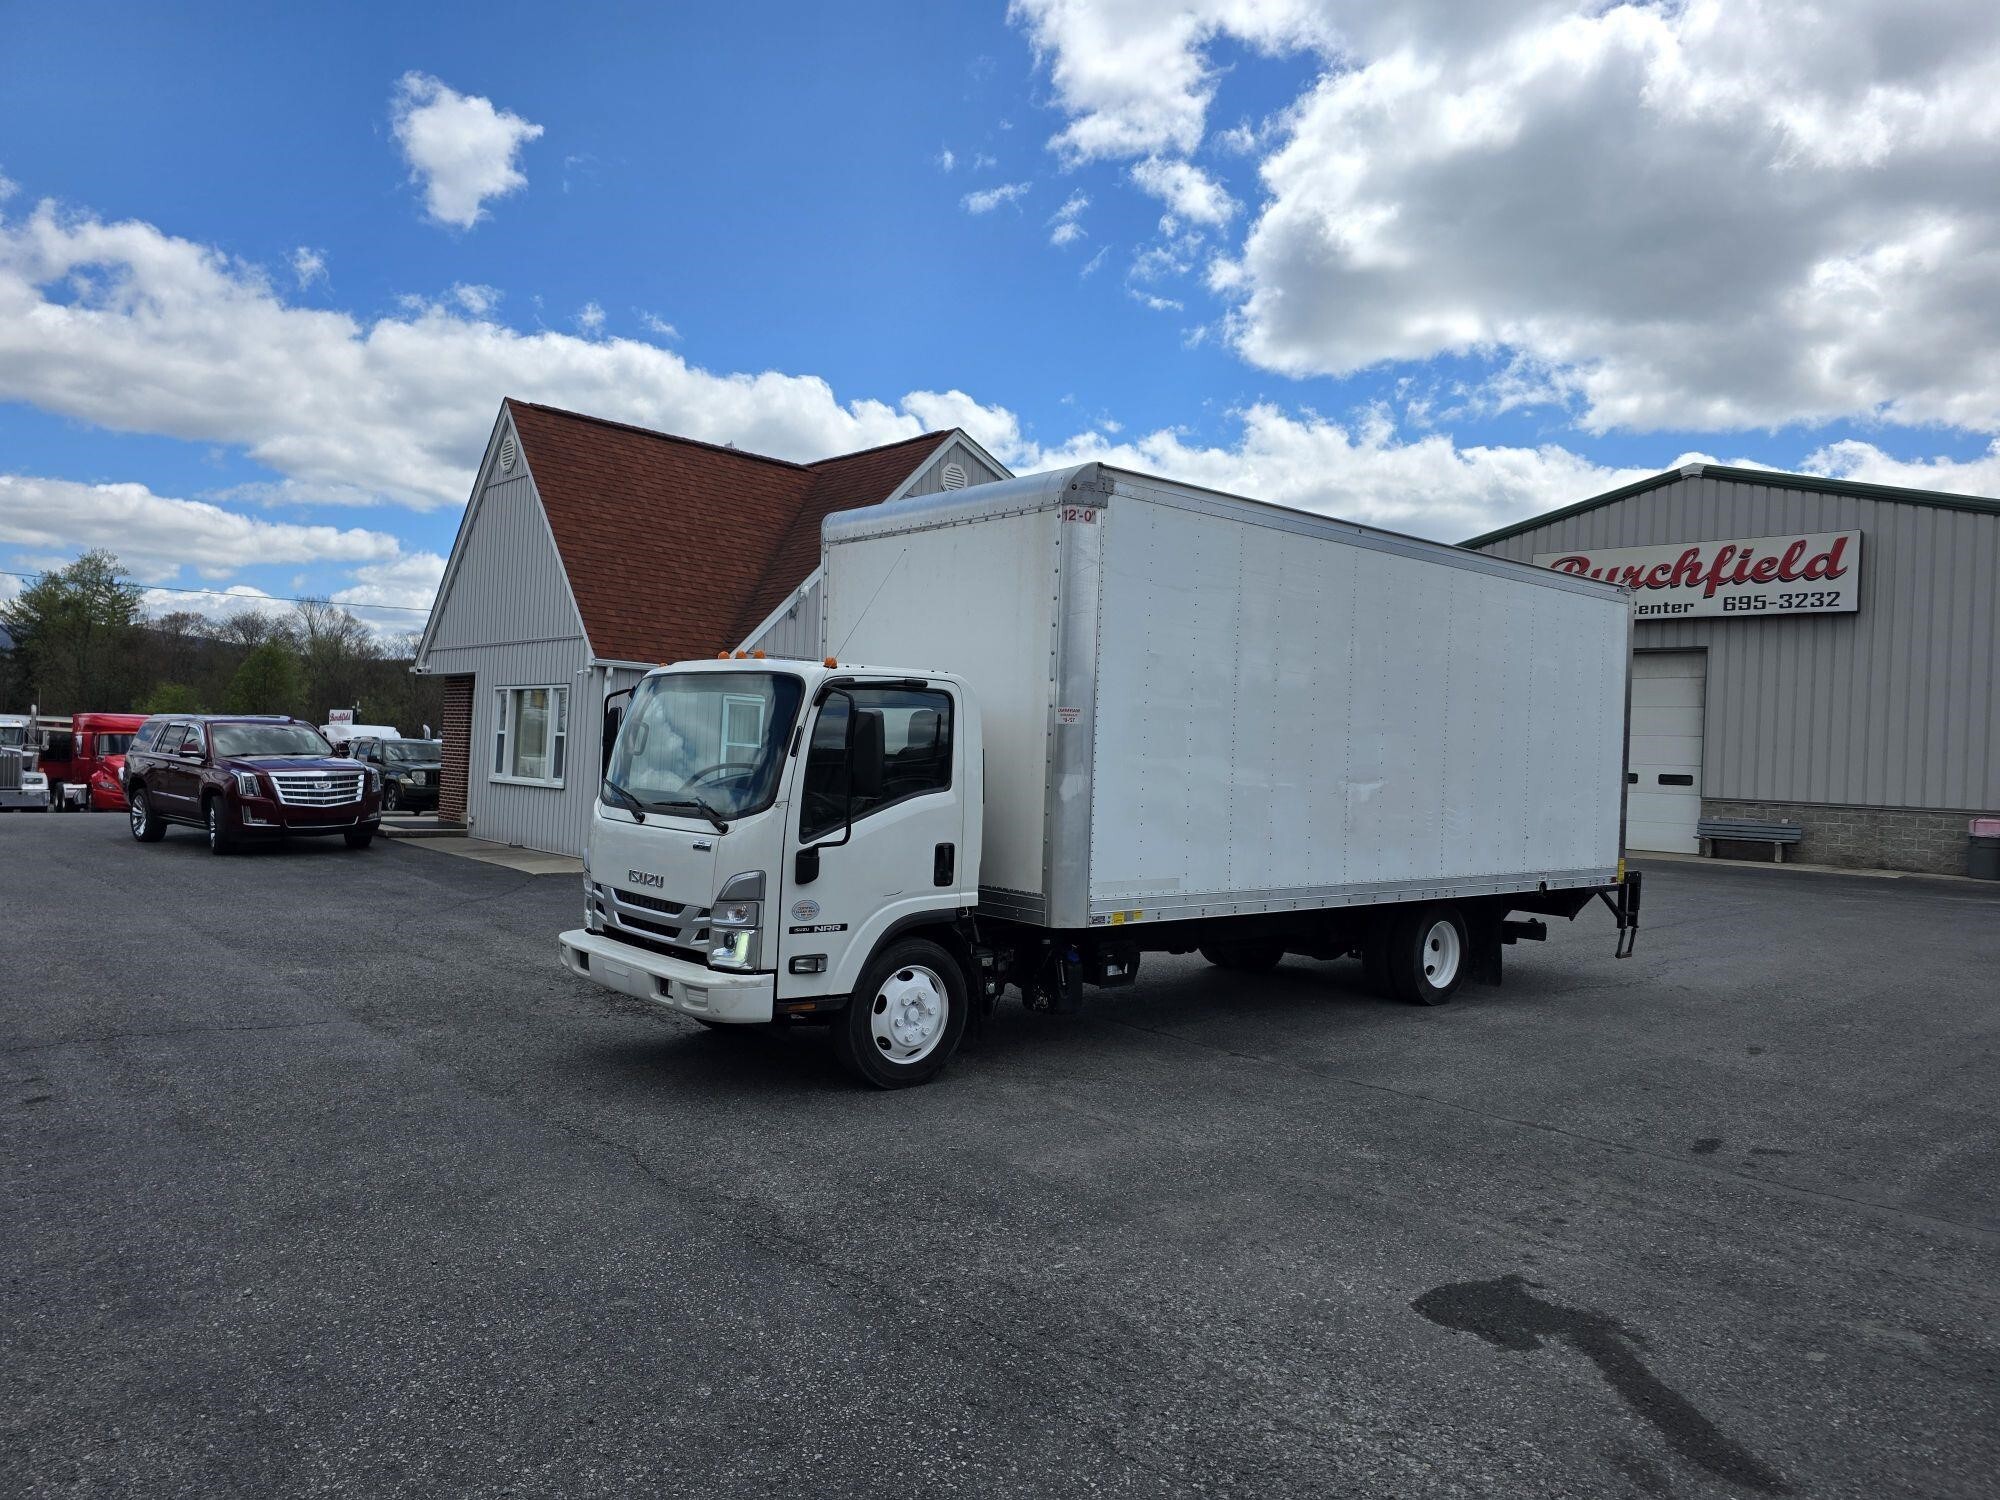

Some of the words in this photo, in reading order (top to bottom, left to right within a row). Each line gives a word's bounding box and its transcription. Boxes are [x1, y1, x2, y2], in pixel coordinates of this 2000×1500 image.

[1634, 601, 1695, 615] enter
[1722, 591, 1841, 612] 695-3232
[628, 869, 665, 888] ISUZU
